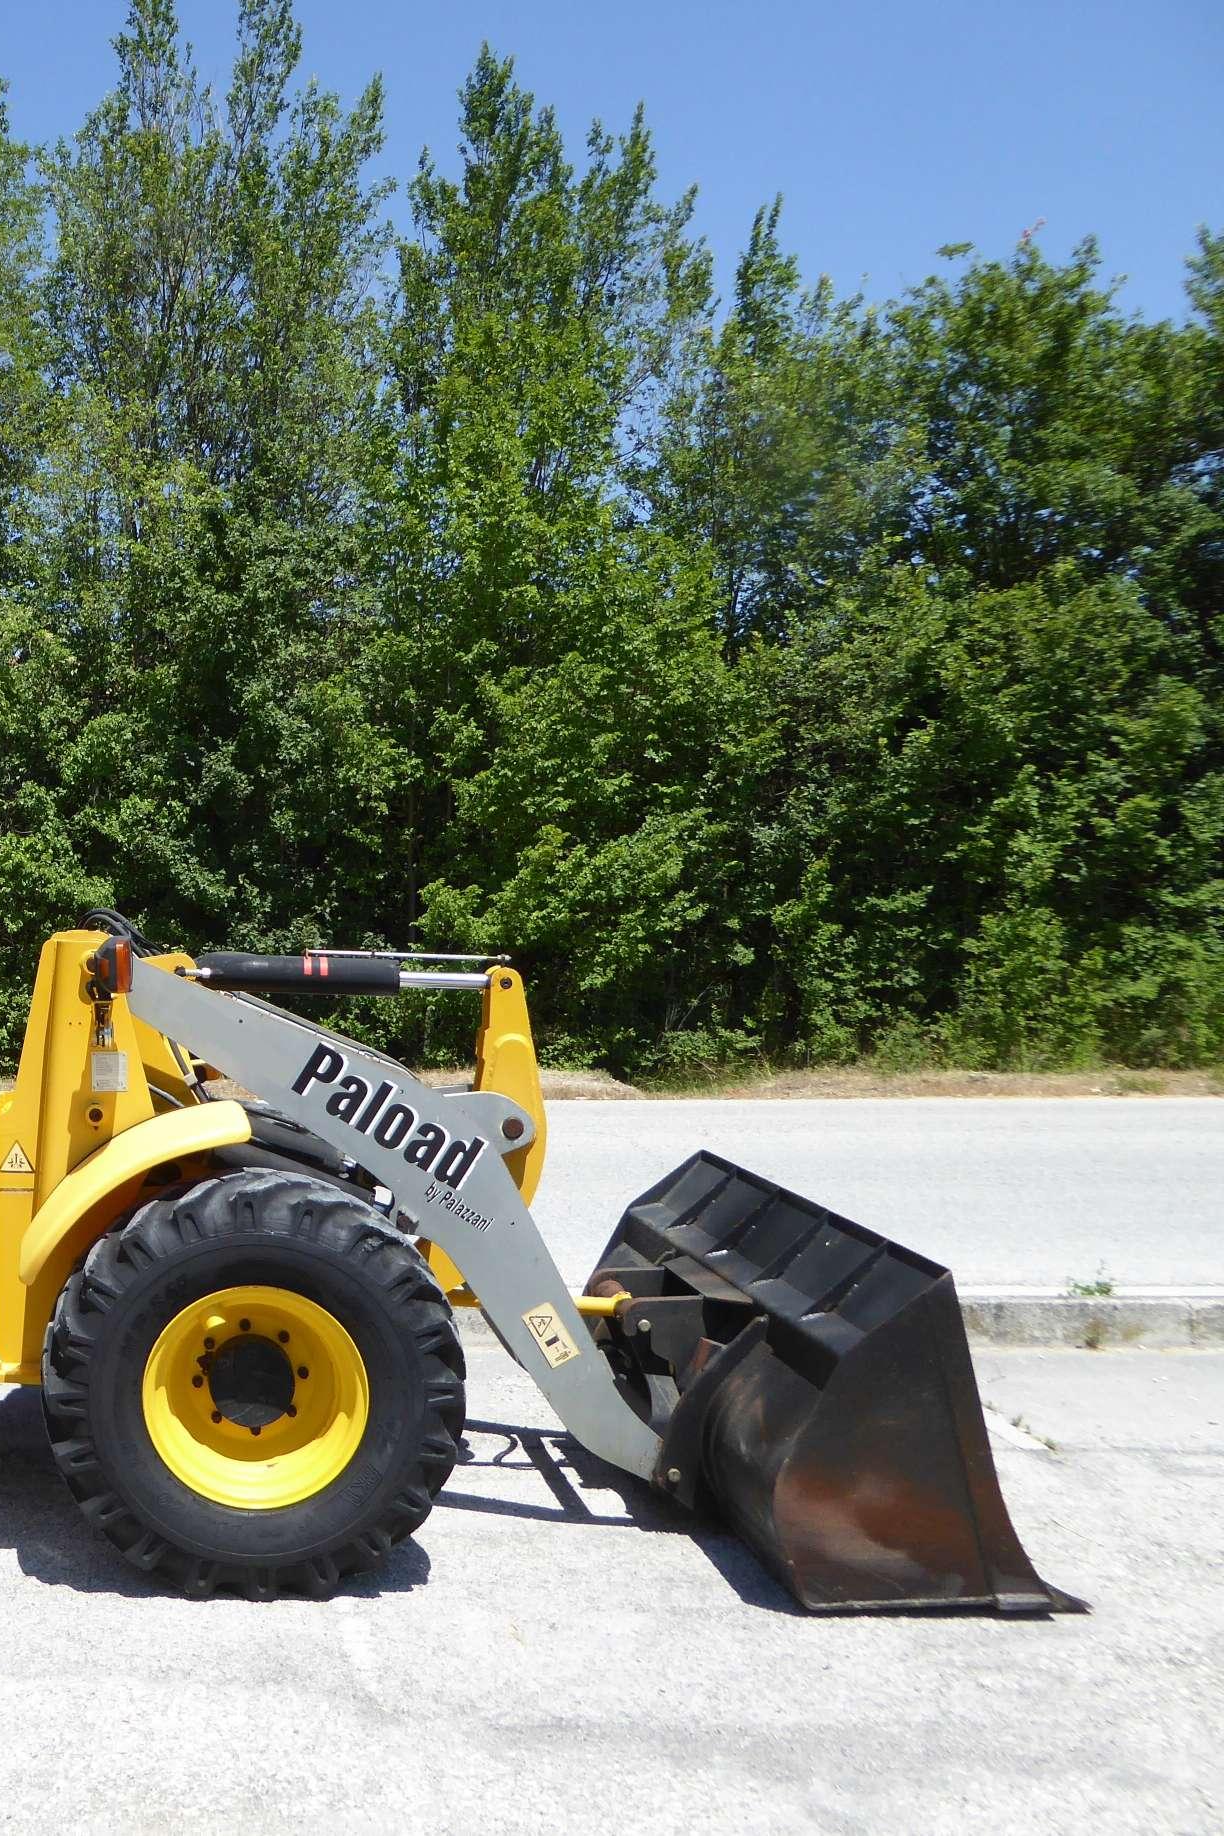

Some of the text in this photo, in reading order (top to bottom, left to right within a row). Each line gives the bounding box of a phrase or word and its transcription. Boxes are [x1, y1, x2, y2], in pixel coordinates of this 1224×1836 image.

[291, 1041, 489, 1191] Paload
[424, 1182, 494, 1232] by Palazzani
